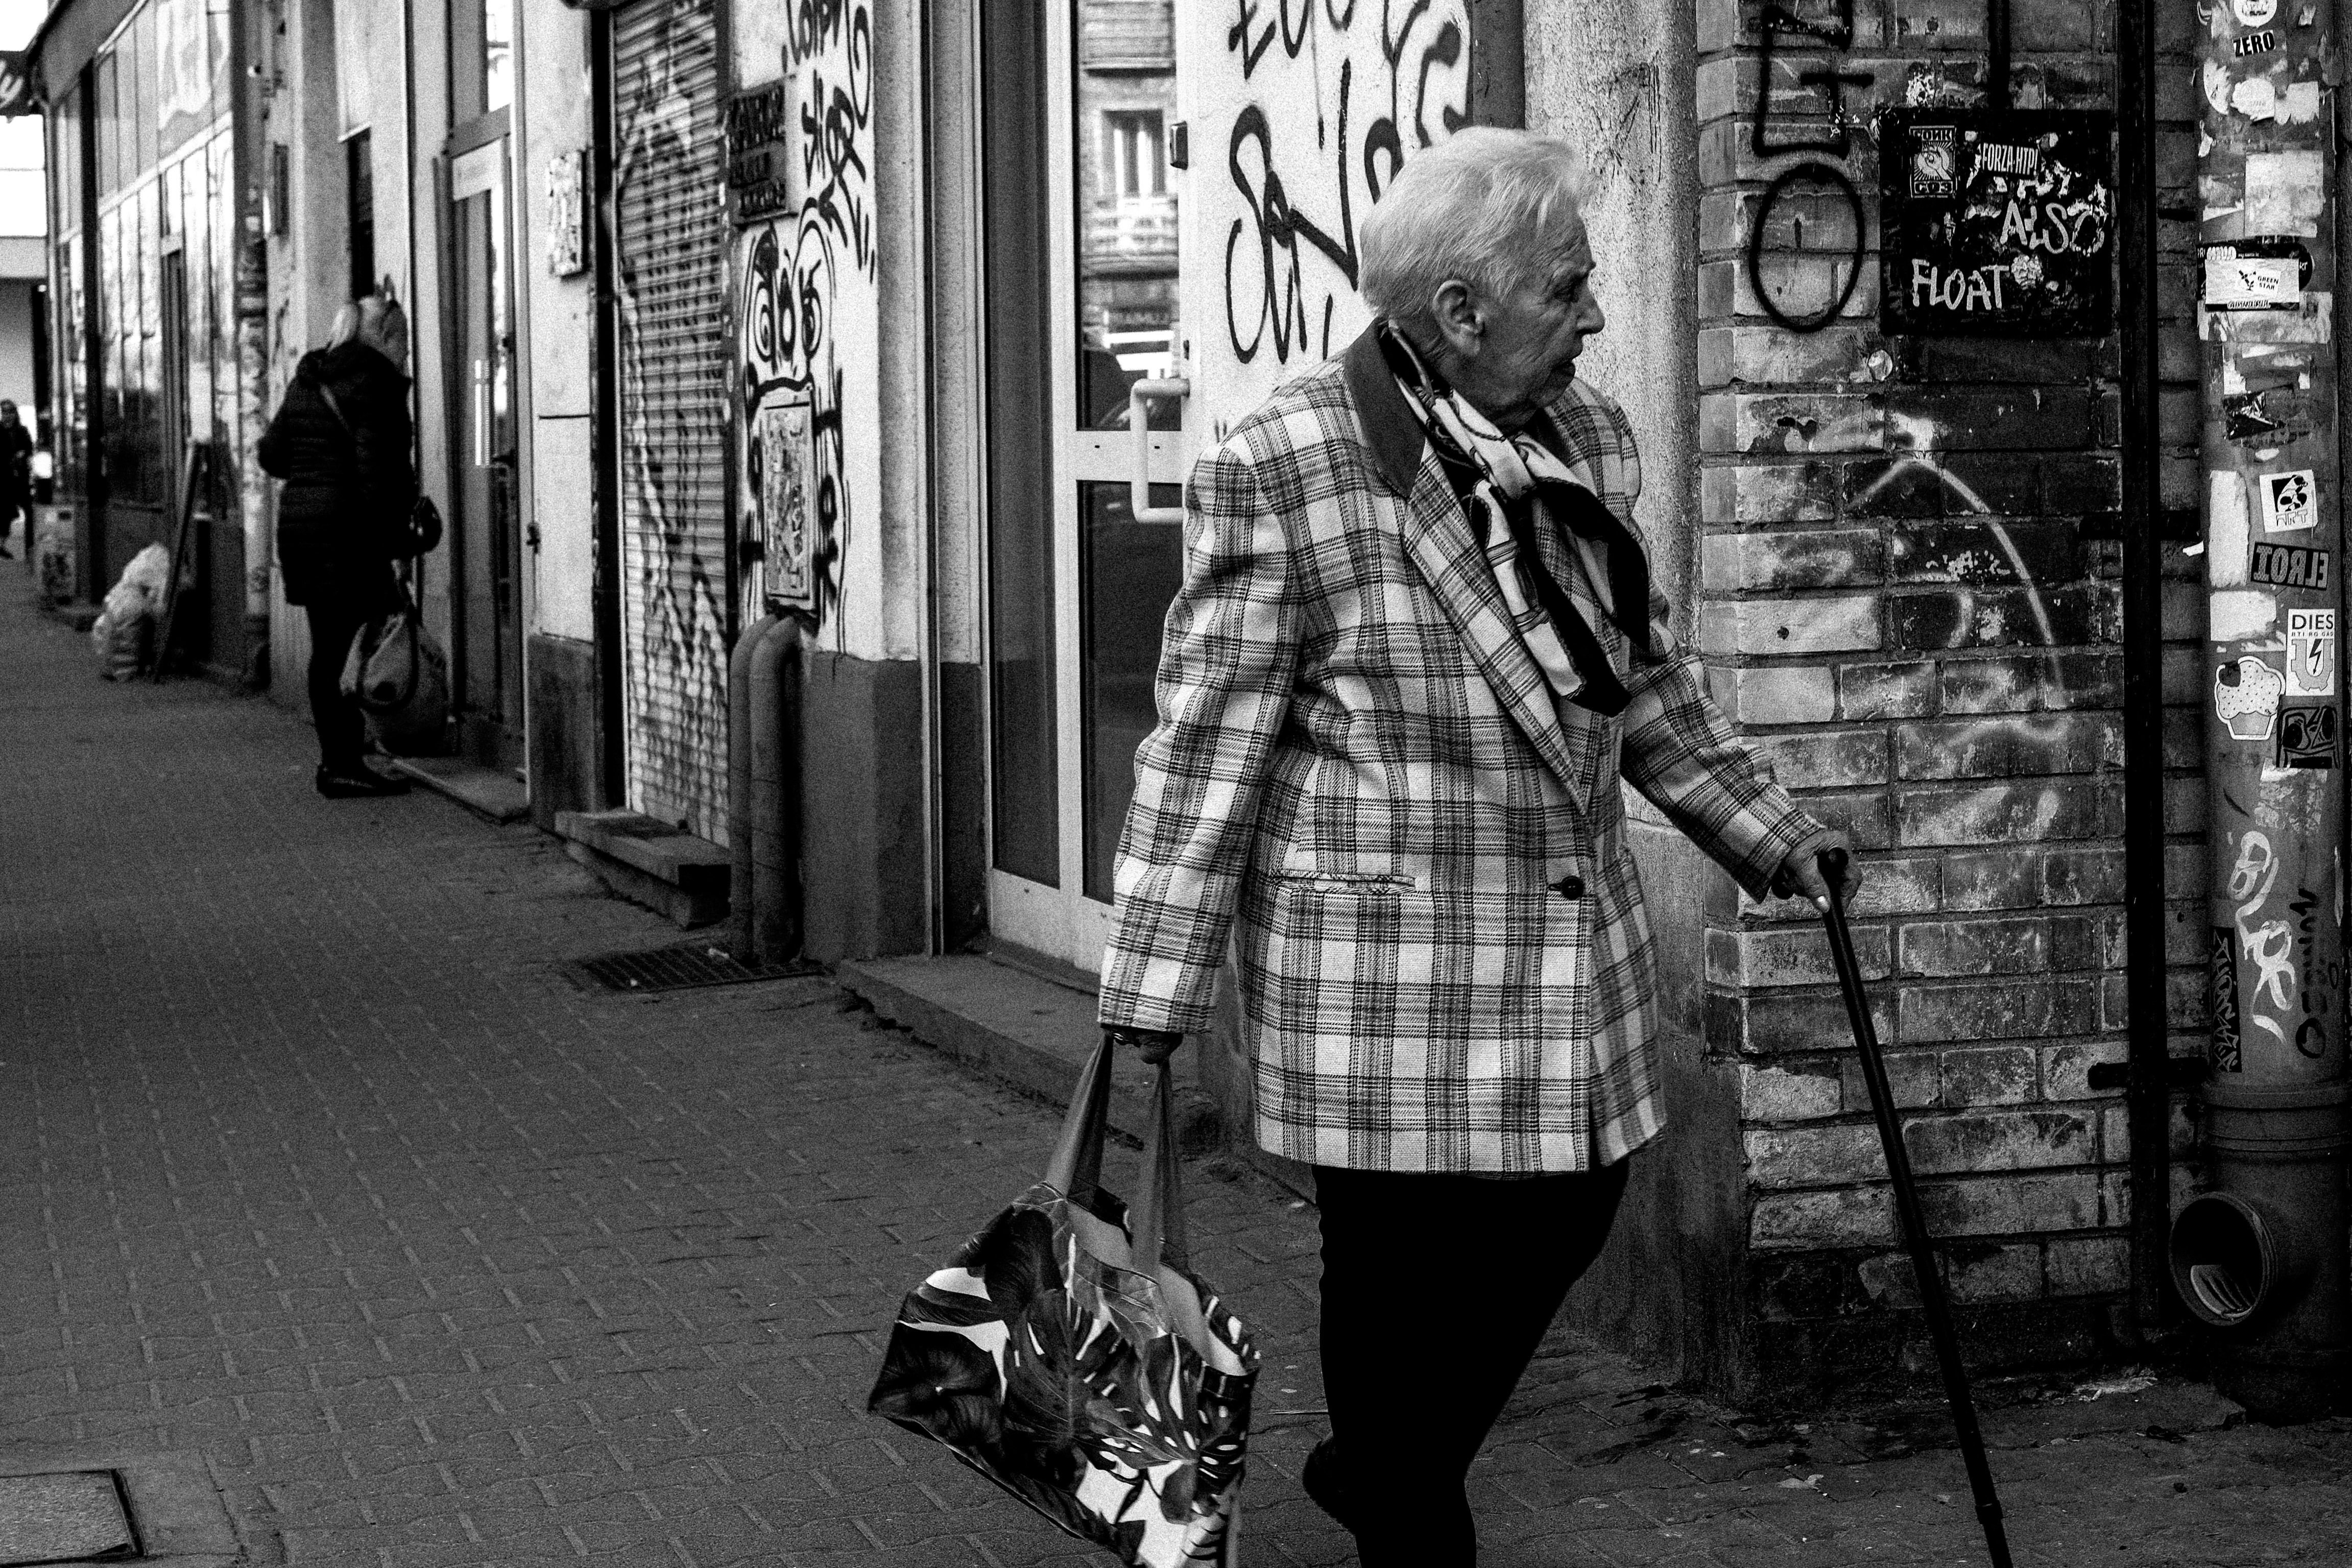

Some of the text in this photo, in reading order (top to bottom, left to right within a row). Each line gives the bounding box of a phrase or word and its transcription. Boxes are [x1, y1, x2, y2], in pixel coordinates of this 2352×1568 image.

[2233, 32, 2275, 58] ZERO
[2000, 199, 2106, 257] ALSO
[1911, 258, 2009, 311] FLOAT
[2258, 275, 2279, 284] GREEN
[2259, 282, 2275, 291] STAR
[2292, 614, 2334, 630] DIES
